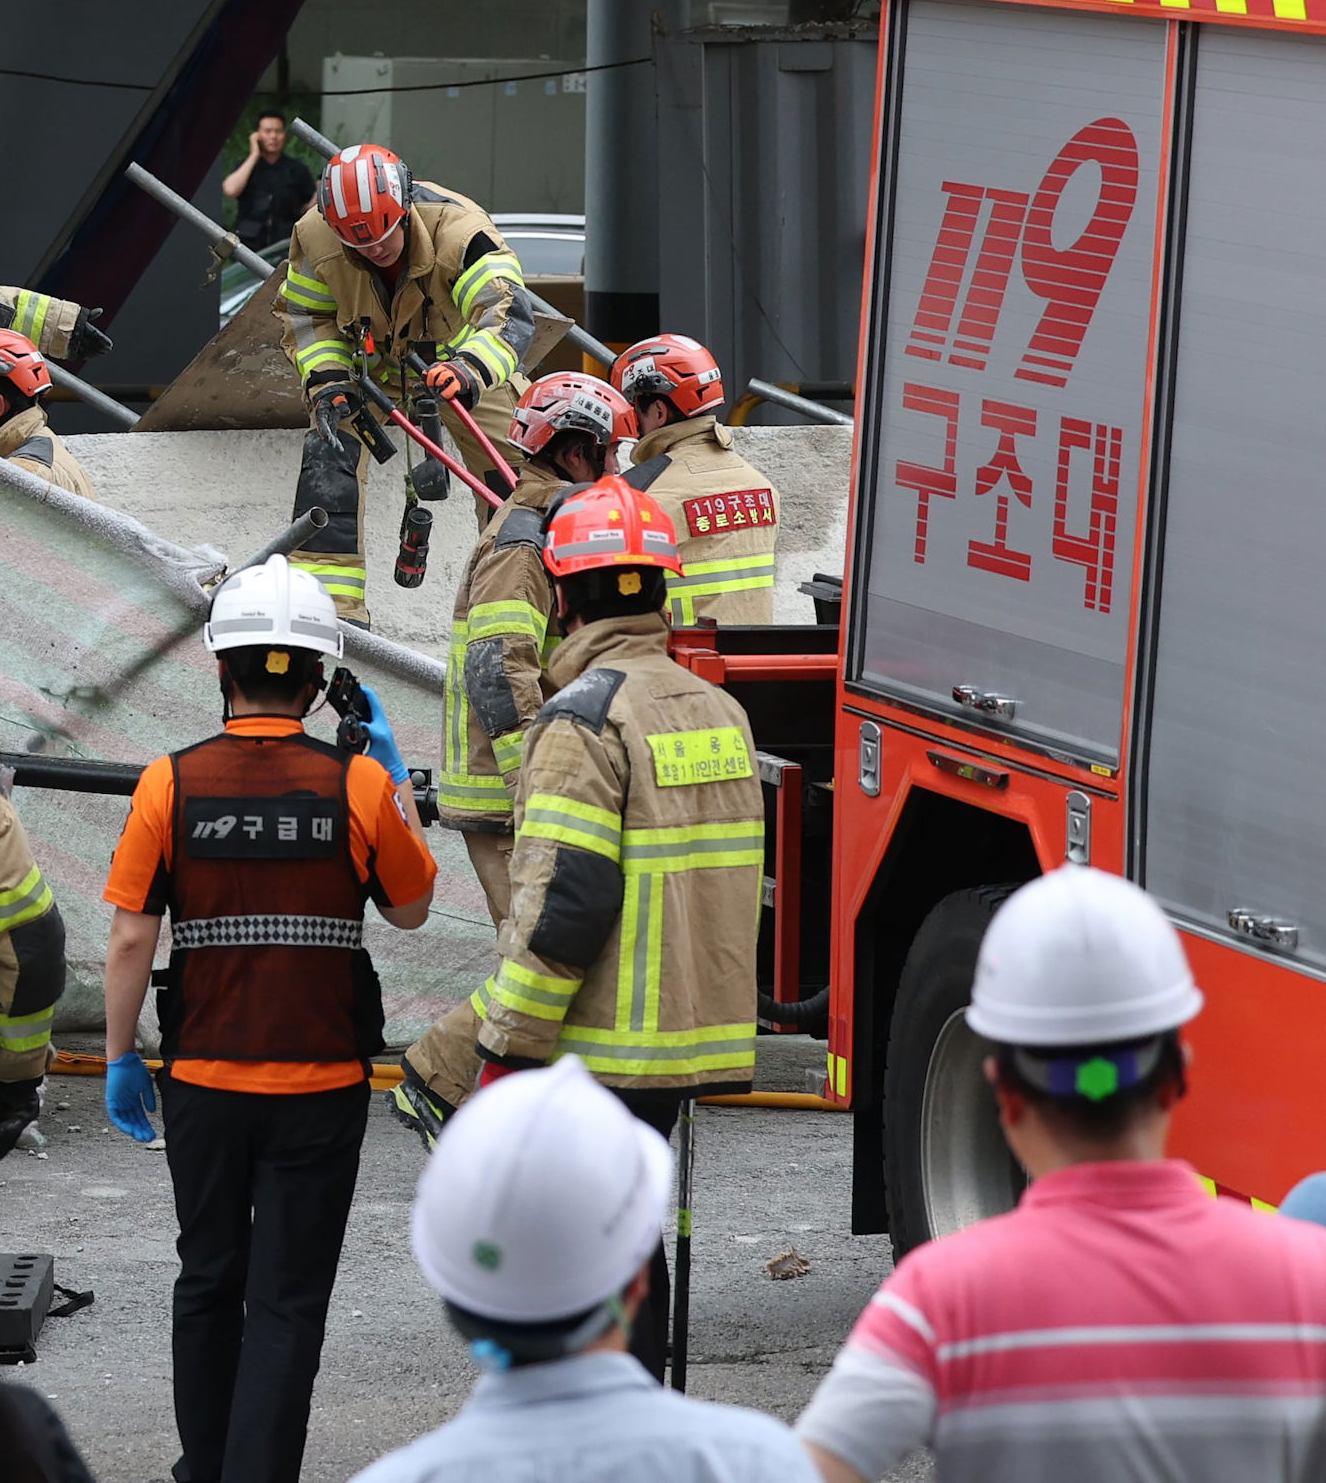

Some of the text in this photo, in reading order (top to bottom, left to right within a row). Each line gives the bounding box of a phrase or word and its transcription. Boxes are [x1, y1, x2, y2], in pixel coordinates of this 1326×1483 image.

[903, 116, 1140, 389] 119
[691, 492, 770, 516] 119구조대
[894, 381, 1123, 614] 구조대
[695, 508, 773, 532] 종로소방서
[191, 815, 333, 842] 119구급대
